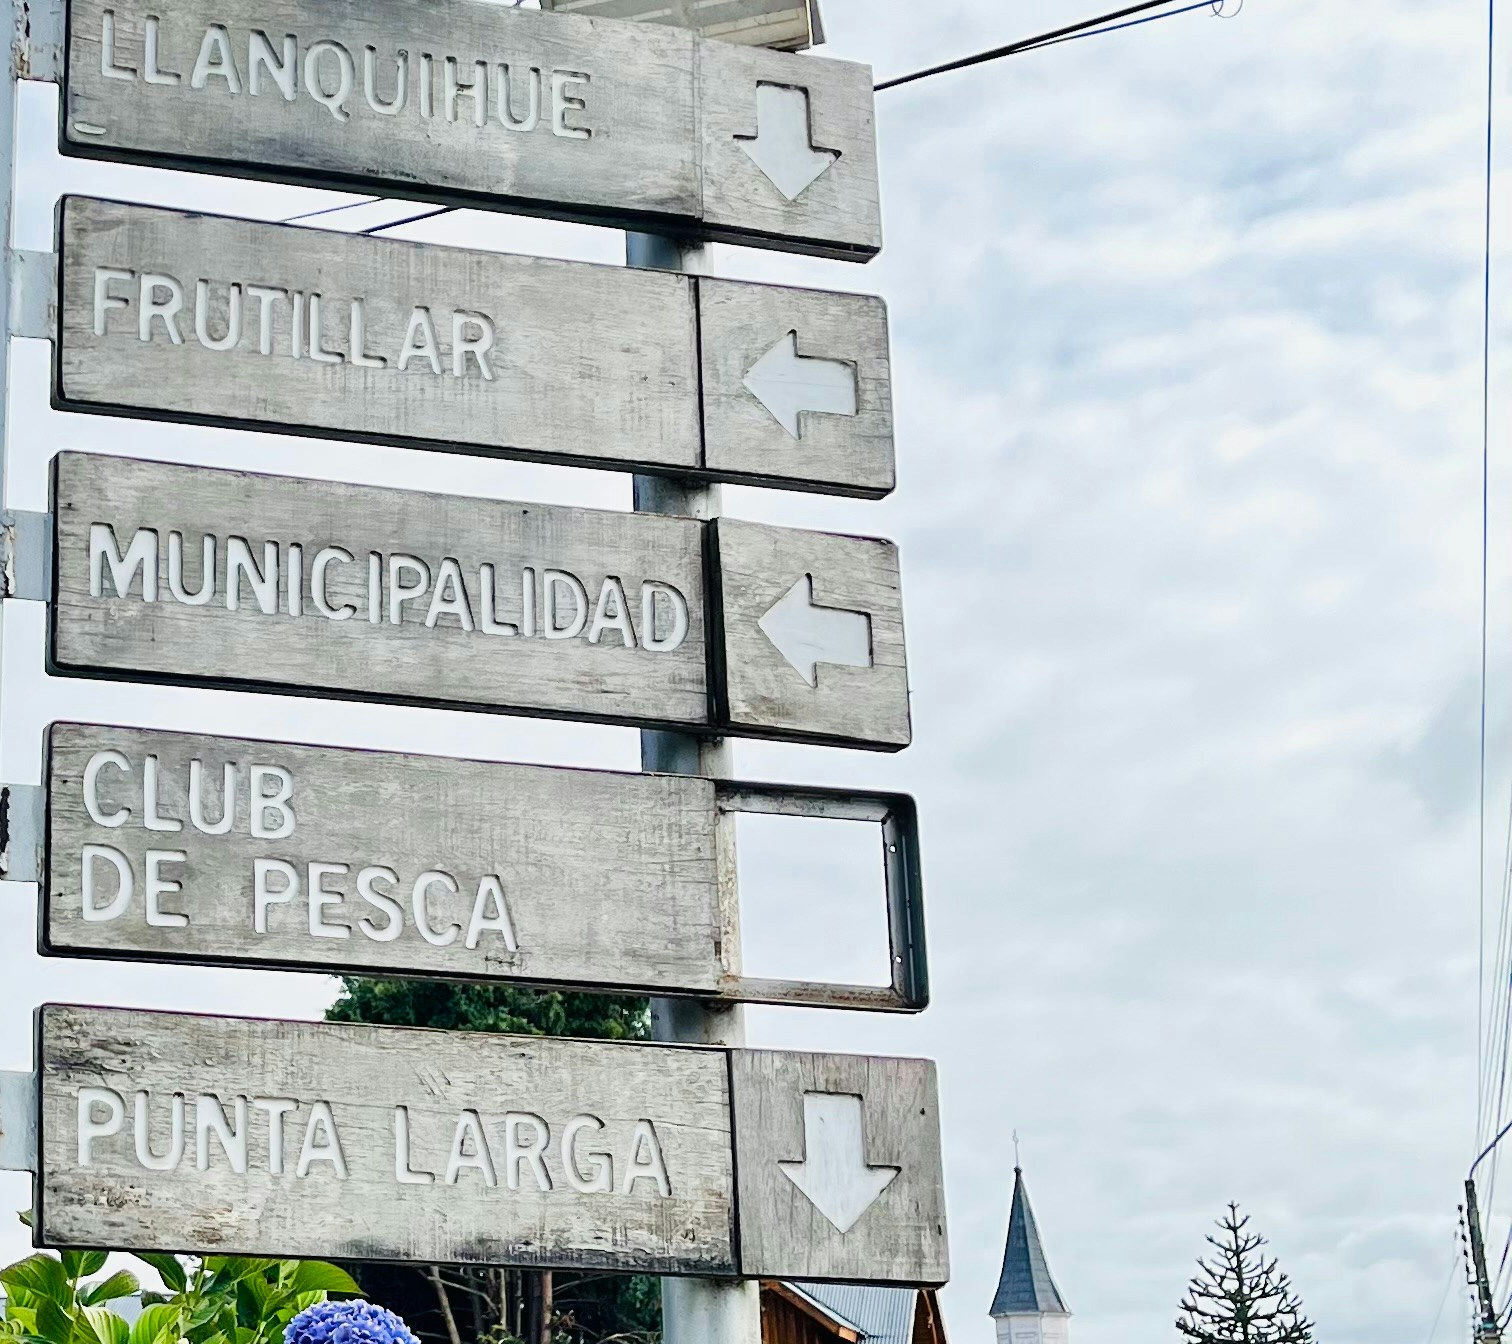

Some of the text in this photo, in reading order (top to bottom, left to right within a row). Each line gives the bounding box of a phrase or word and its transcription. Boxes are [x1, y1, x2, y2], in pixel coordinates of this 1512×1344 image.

[101, 9, 593, 140] LLANQUIHUE
[92, 267, 496, 381] FRUTILLAR
[89, 521, 690, 654] MUNICIPALIDAD
[82, 749, 296, 840] CLUB
[81, 843, 520, 952] DE PESCA
[77, 1086, 673, 1197] PUNTA LARGA
